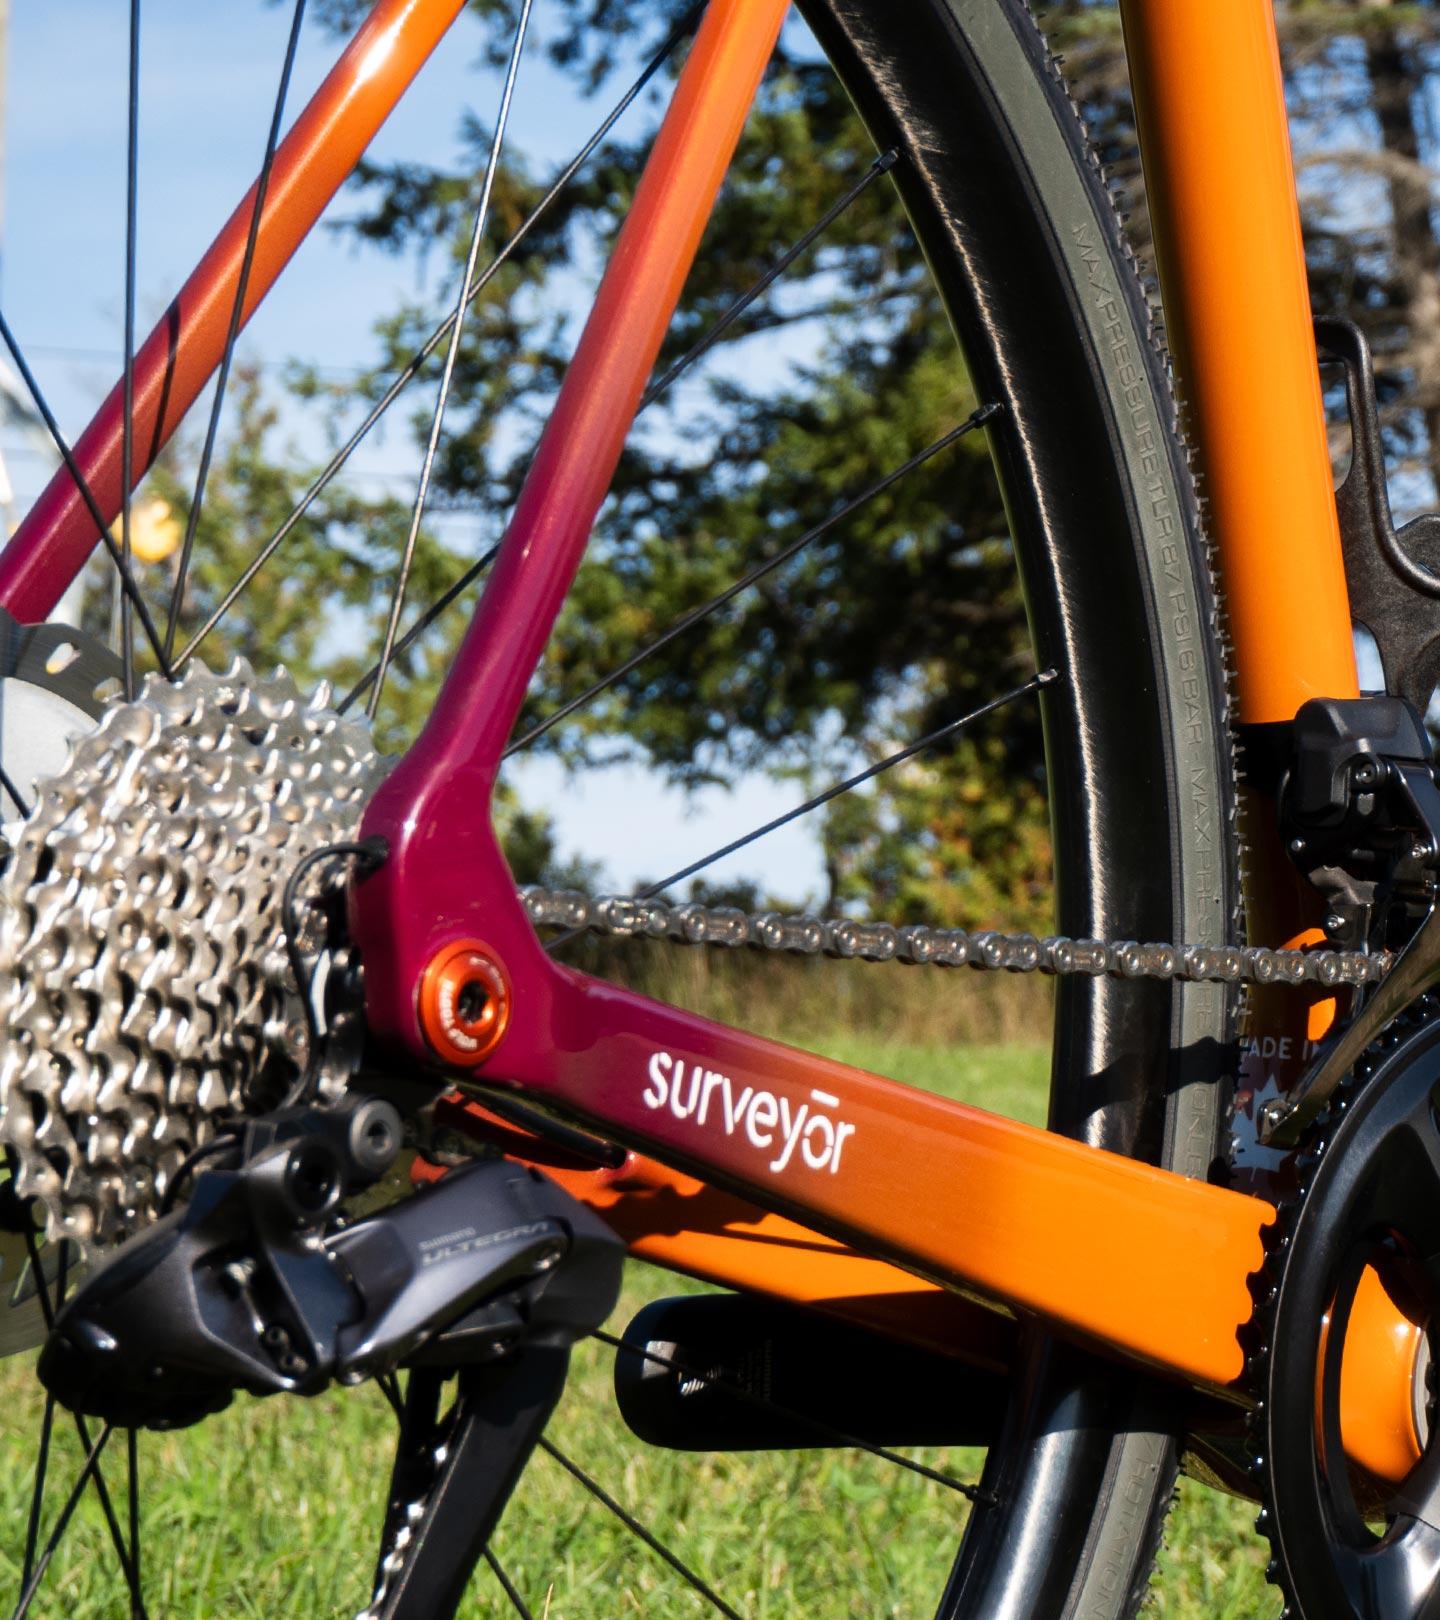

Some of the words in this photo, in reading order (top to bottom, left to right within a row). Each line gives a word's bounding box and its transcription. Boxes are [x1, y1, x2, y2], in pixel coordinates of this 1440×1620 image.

[1072, 223, 1111, 302] MAX
[1098, 298, 1160, 475] PRESSURE
[1149, 480, 1174, 539] TLR
[1161, 544, 1183, 583] 87
[1169, 592, 1192, 643] PSI
[1178, 650, 1195, 672] 6
[1182, 677, 1202, 746] BAR
[1191, 767, 1213, 846] MAX
[1242, 1036, 1293, 1060] ADE
[643, 1052, 856, 1174] surveyōr
